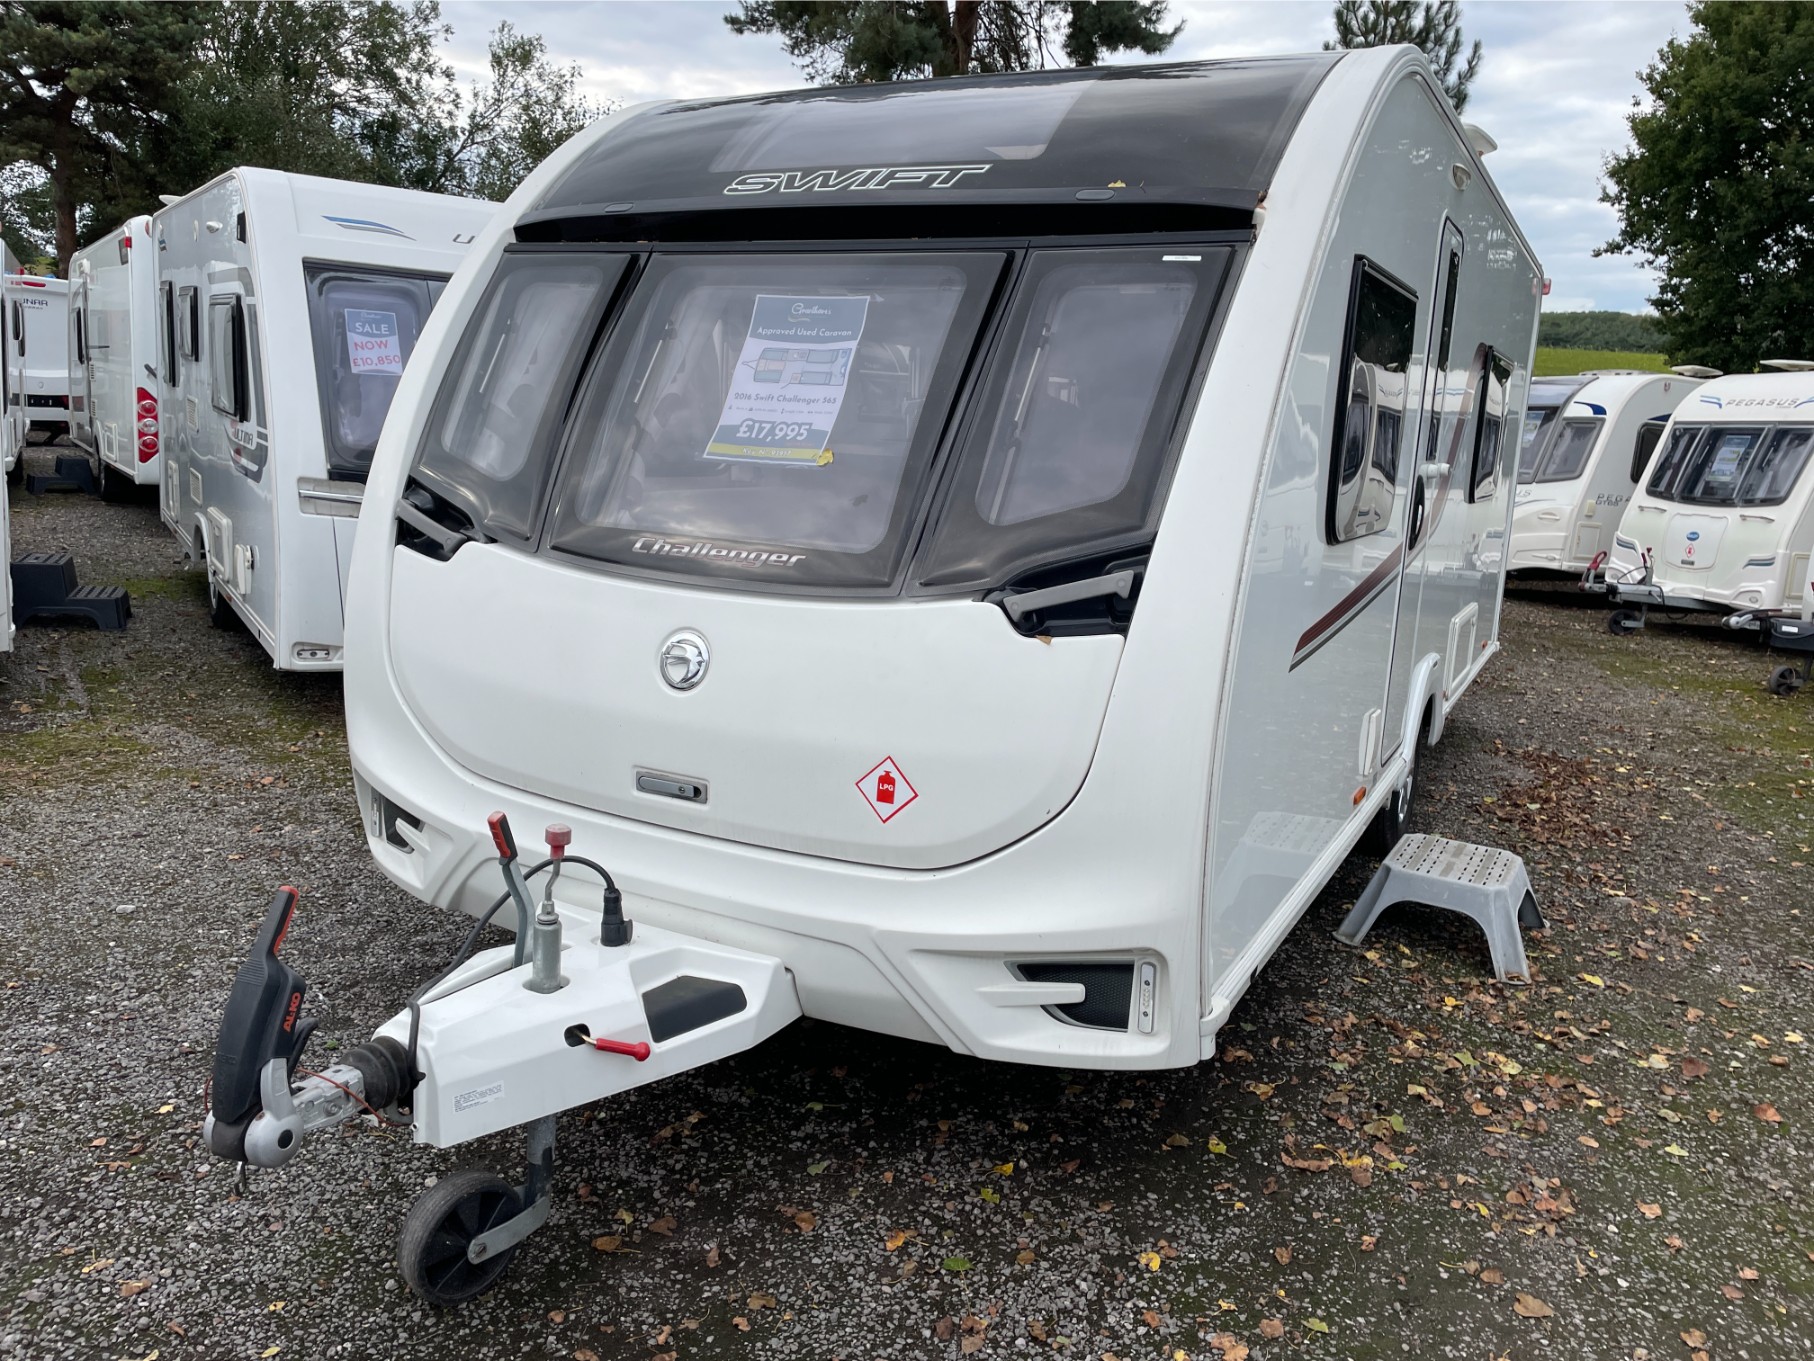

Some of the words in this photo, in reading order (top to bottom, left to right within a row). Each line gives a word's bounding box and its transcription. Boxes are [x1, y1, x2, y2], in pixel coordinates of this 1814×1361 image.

[723, 164, 993, 195] SWIFT
[355, 322, 389, 340] SALE
[757, 326, 796, 336] Approved
[797, 327, 818, 336] Used
[819, 328, 852, 337] Caravan
[353, 339, 389, 351] NOW
[734, 391, 752, 401] 2016
[753, 393, 775, 402] Swift
[776, 394, 821, 406] Challenger
[1725, 398, 1800, 408] PEGASUS
[735, 417, 810, 442] £17,995
[632, 537, 806, 568] Challenger
[879, 782, 894, 792] LPG
